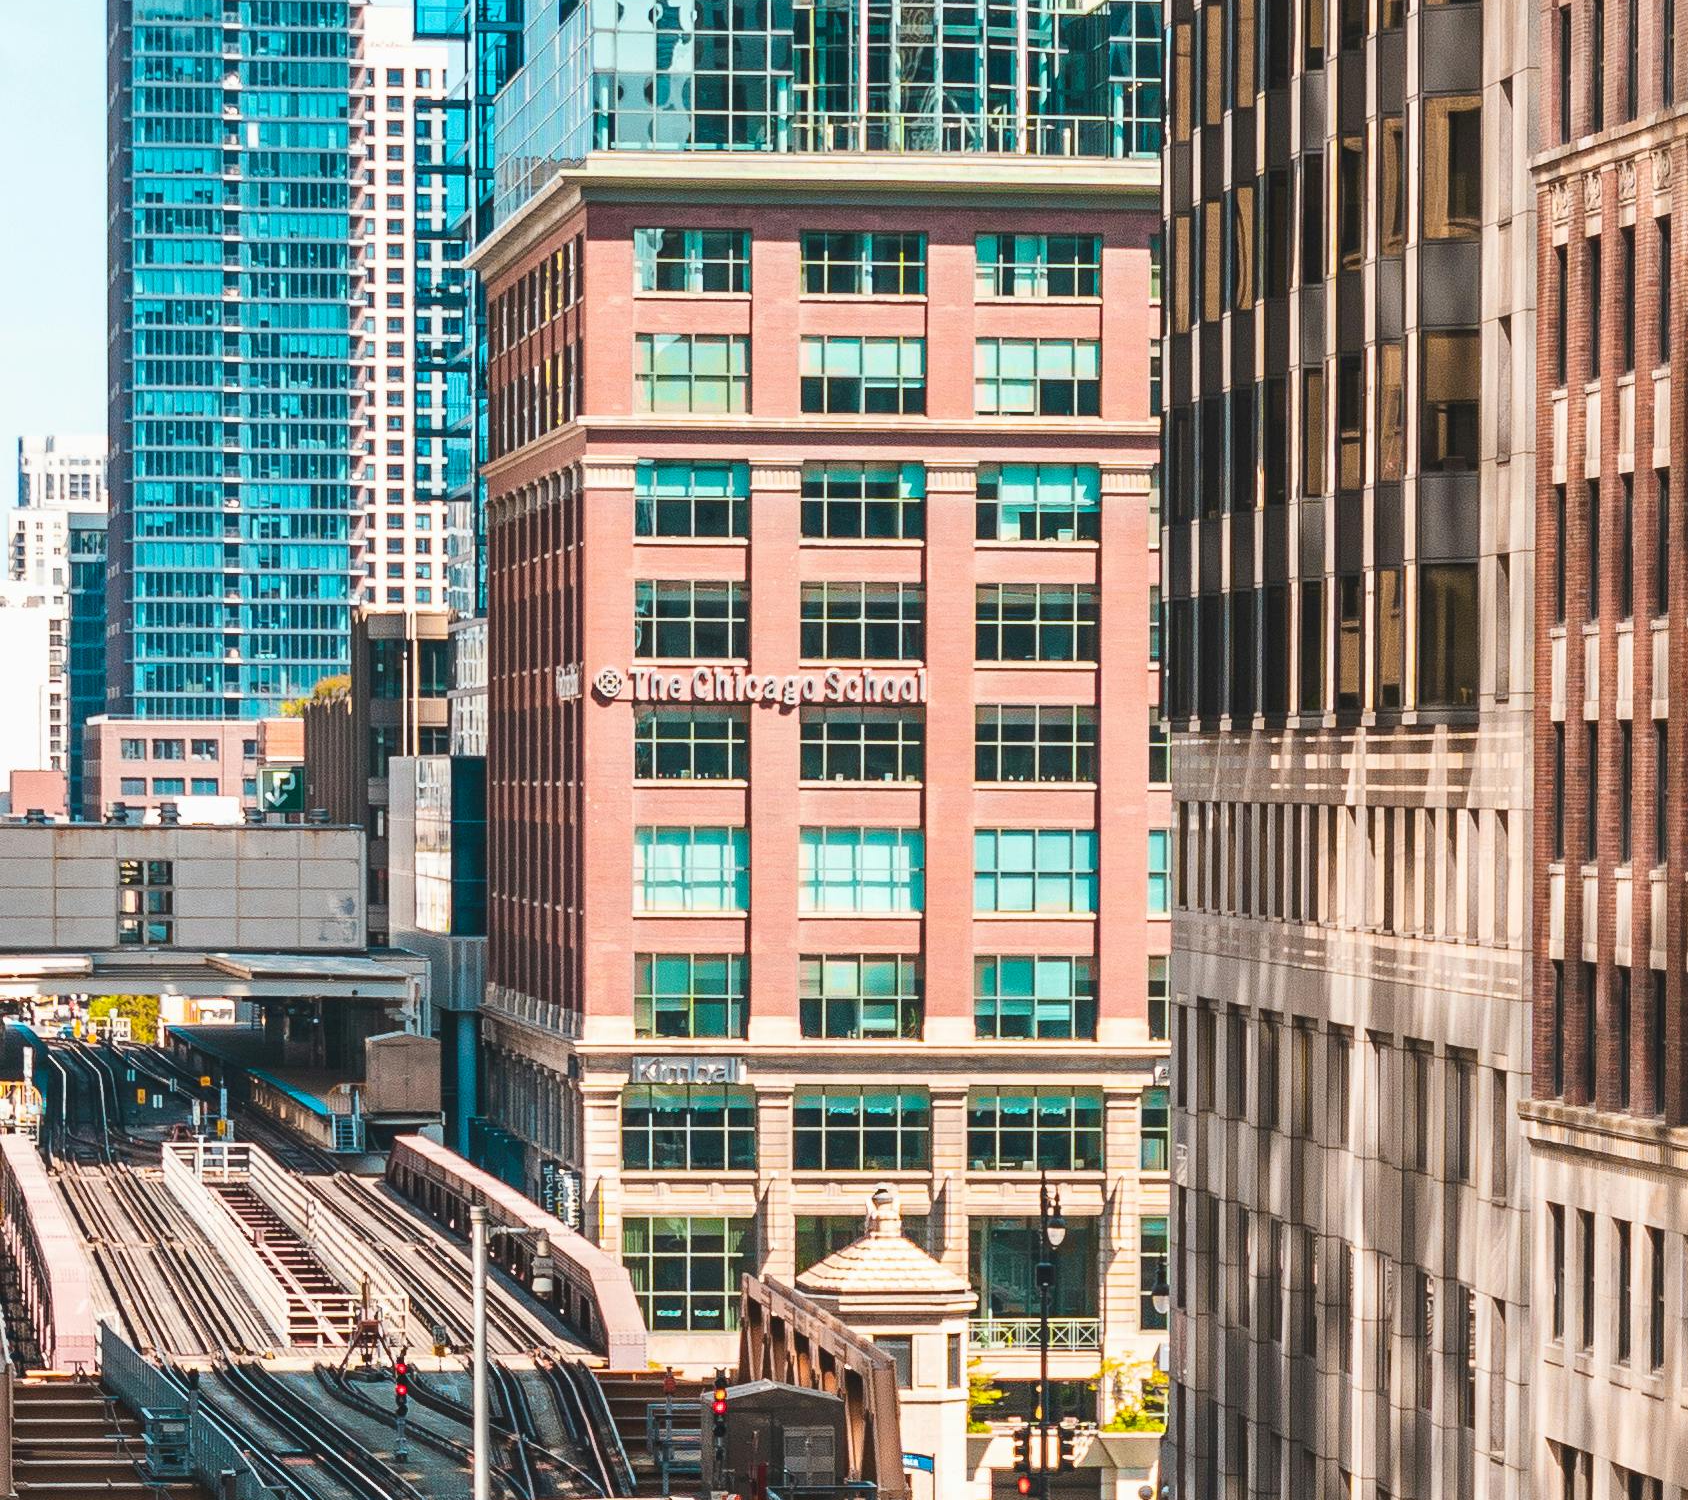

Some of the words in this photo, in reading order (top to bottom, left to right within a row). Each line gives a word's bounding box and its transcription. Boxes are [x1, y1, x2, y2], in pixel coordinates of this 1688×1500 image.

[628, 667, 681, 701] The
[692, 666, 816, 705] Chicago
[824, 667, 927, 703] School
[632, 1056, 748, 1086] Kimball
[543, 1164, 554, 1212] imball
